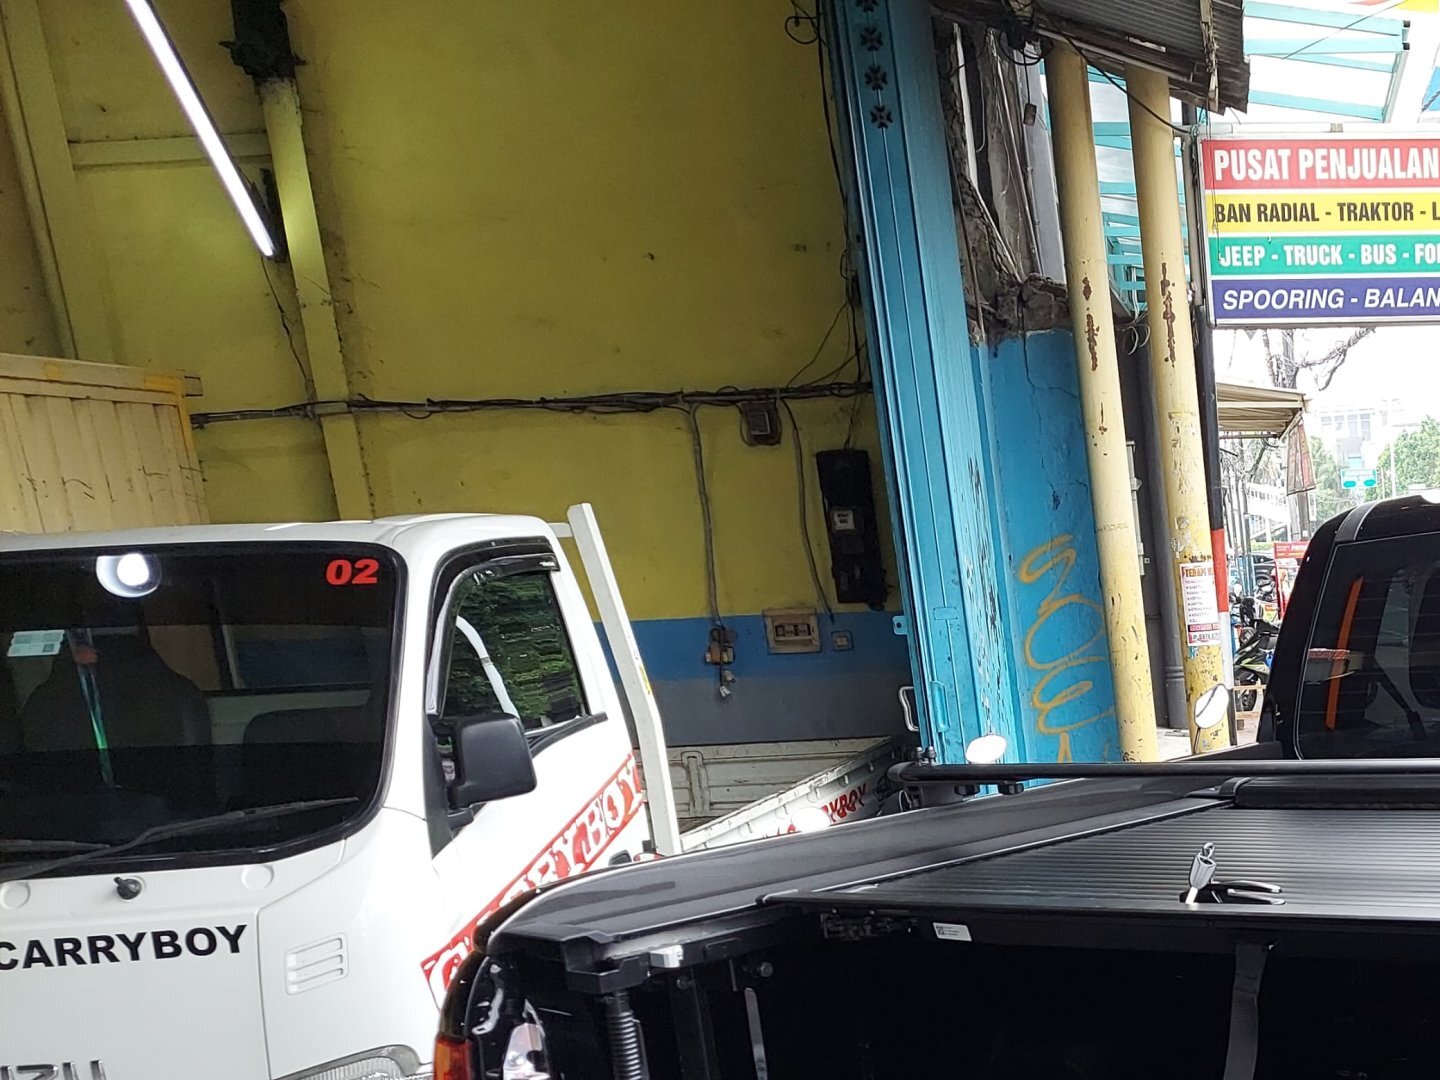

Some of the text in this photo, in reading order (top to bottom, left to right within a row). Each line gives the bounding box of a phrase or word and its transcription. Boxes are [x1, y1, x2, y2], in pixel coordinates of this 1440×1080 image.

[1214, 149, 1292, 181] PUSAT
[1299, 147, 1440, 180] PENJUALAN
[1214, 203, 1252, 223] BAN
[1256, 203, 1320, 223] RADIAL
[1337, 201, 1415, 222] TRAKTOR
[1220, 246, 1266, 267] JEEP
[1283, 245, 1344, 266] TRUCK
[1360, 244, 1397, 265] BUS
[1222, 288, 1345, 311] SPOORING
[325, 558, 380, 585] 02
